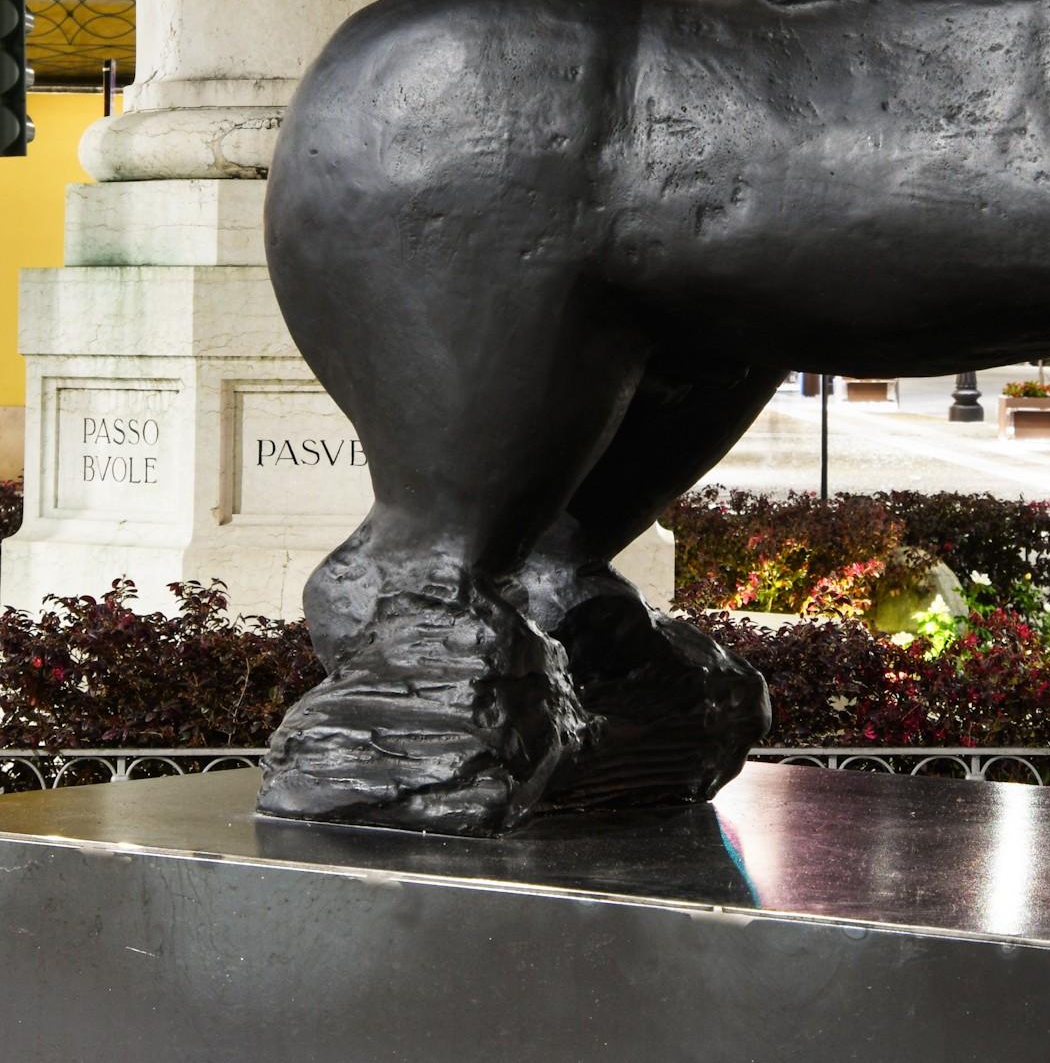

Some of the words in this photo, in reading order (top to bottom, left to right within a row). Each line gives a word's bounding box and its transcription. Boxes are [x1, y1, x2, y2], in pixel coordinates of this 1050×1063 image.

[83, 417, 159, 445] PASSO
[257, 439, 368, 467] PASVB
[83, 455, 158, 484] BVOLE
